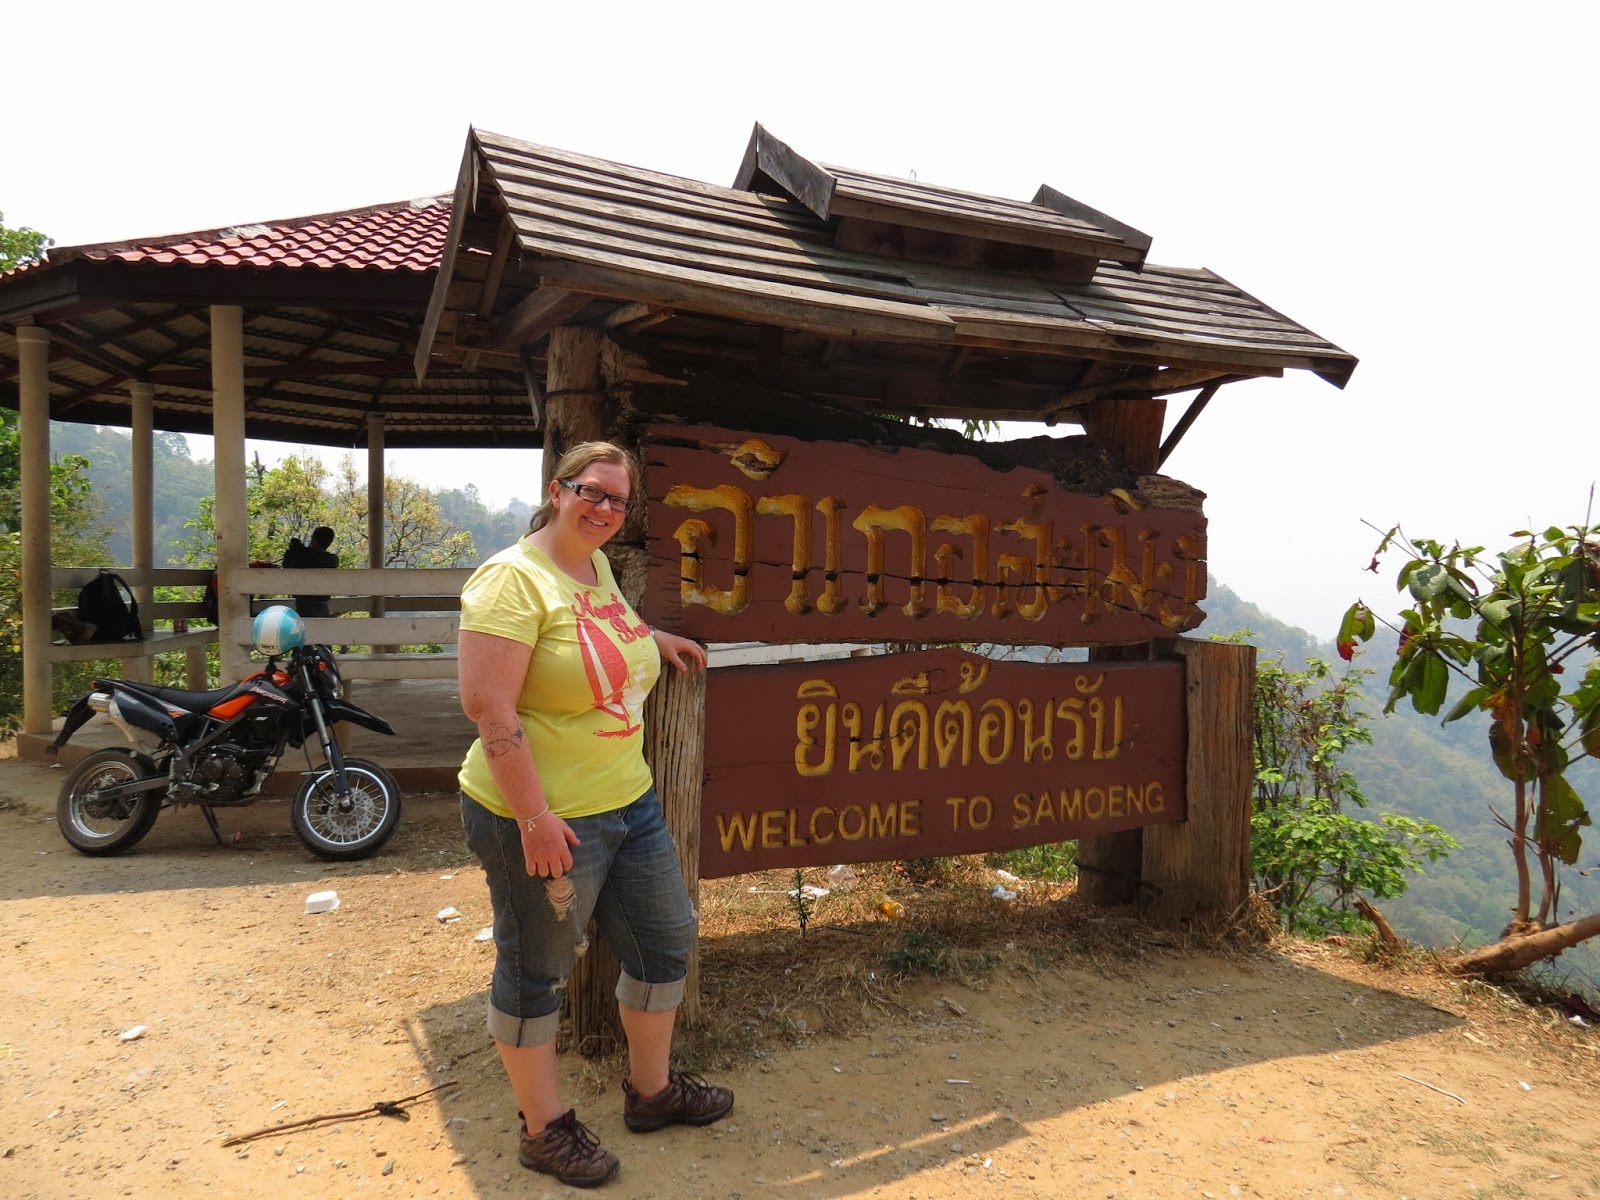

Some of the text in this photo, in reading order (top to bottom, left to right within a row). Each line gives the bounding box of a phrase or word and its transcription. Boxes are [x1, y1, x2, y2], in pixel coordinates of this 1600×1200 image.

[794, 660, 1124, 777] ยินดีต้อนรับ
[715, 781, 1167, 853] WELCOME TO SAMOENG
